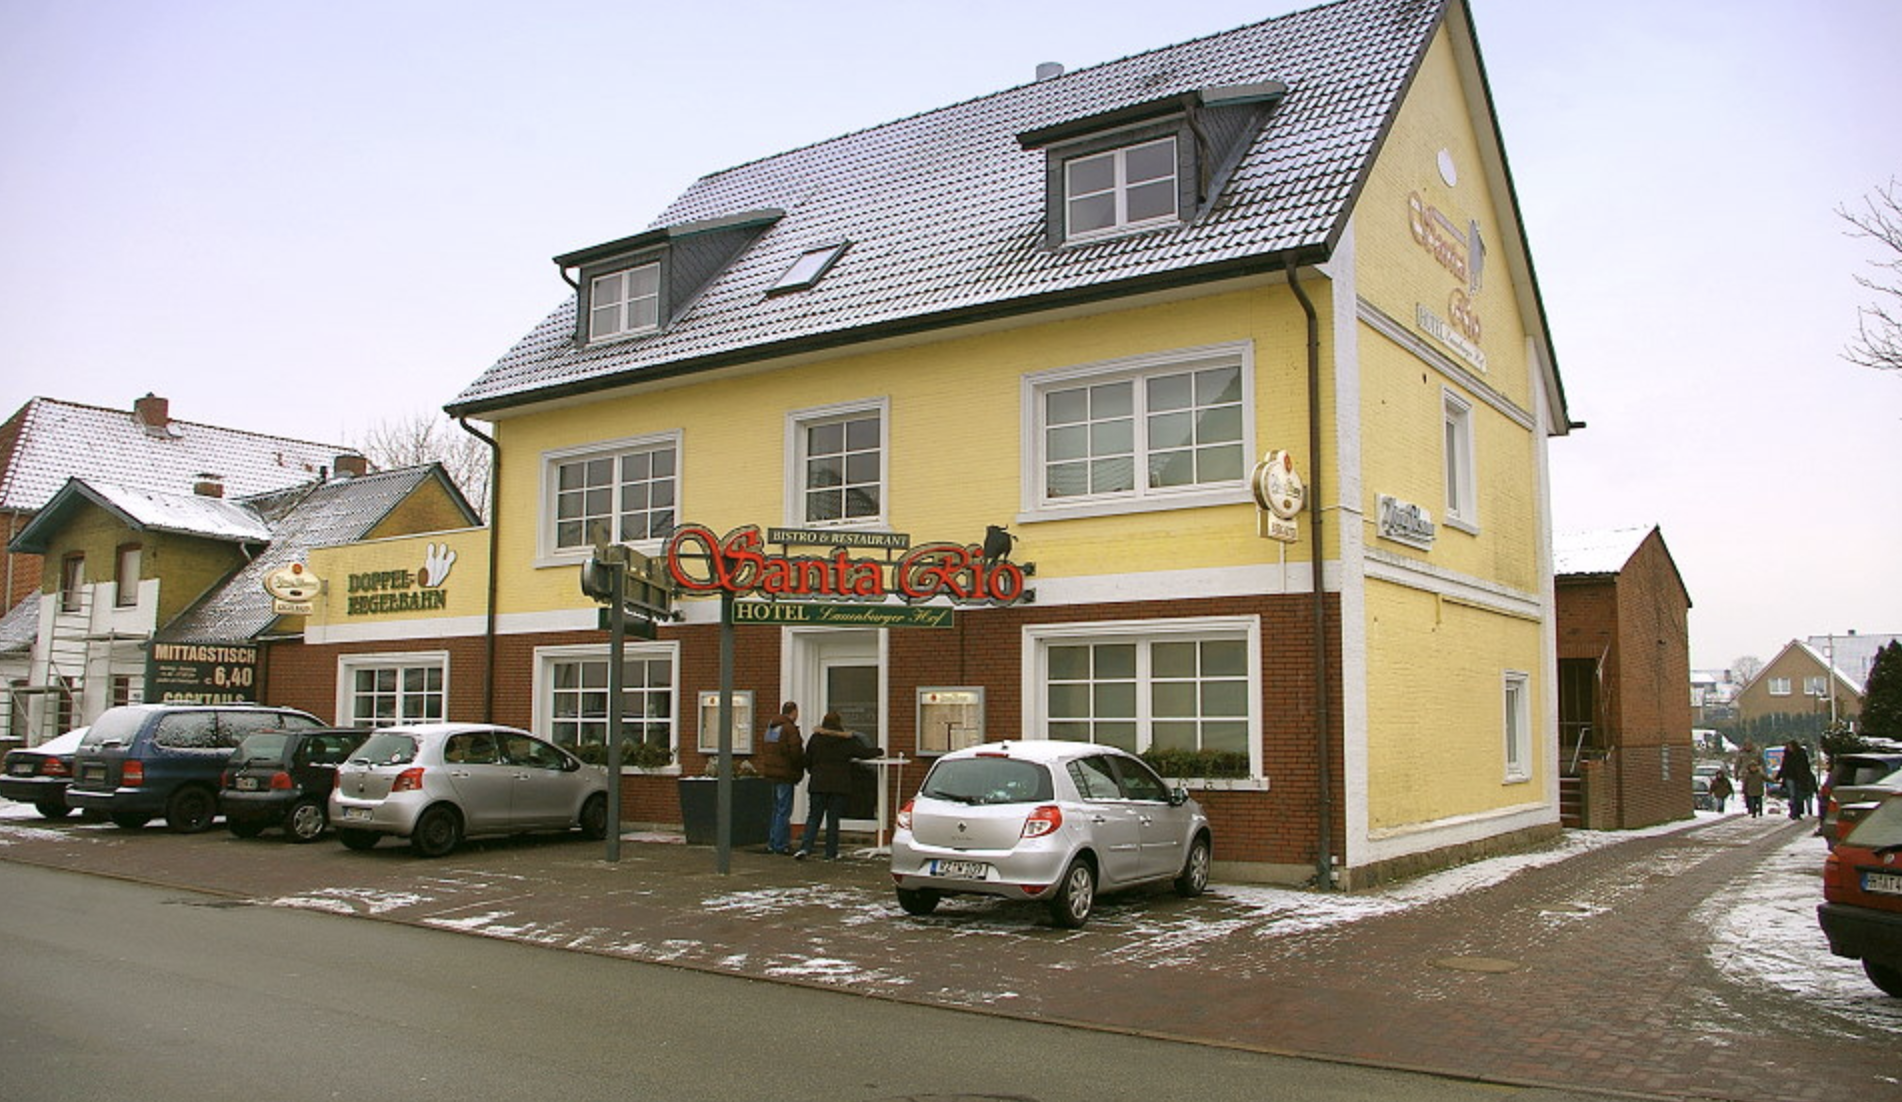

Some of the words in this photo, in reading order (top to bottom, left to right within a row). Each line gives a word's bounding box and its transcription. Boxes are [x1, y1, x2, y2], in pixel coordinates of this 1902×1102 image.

[773, 531, 817, 543] BISTRO
[819, 533, 828, 544] &
[831, 534, 907, 547] RESTAURANT
[667, 529, 884, 597] Santa
[901, 545, 1024, 601] Rio
[347, 590, 448, 615] KEGELBAHN
[737, 603, 810, 621] HOTEL
[818, 605, 905, 625] Lauenburger
[908, 607, 948, 627] Hof
[154, 643, 257, 664] MITTAGSTISCH
[215, 665, 253, 688] 6,40
